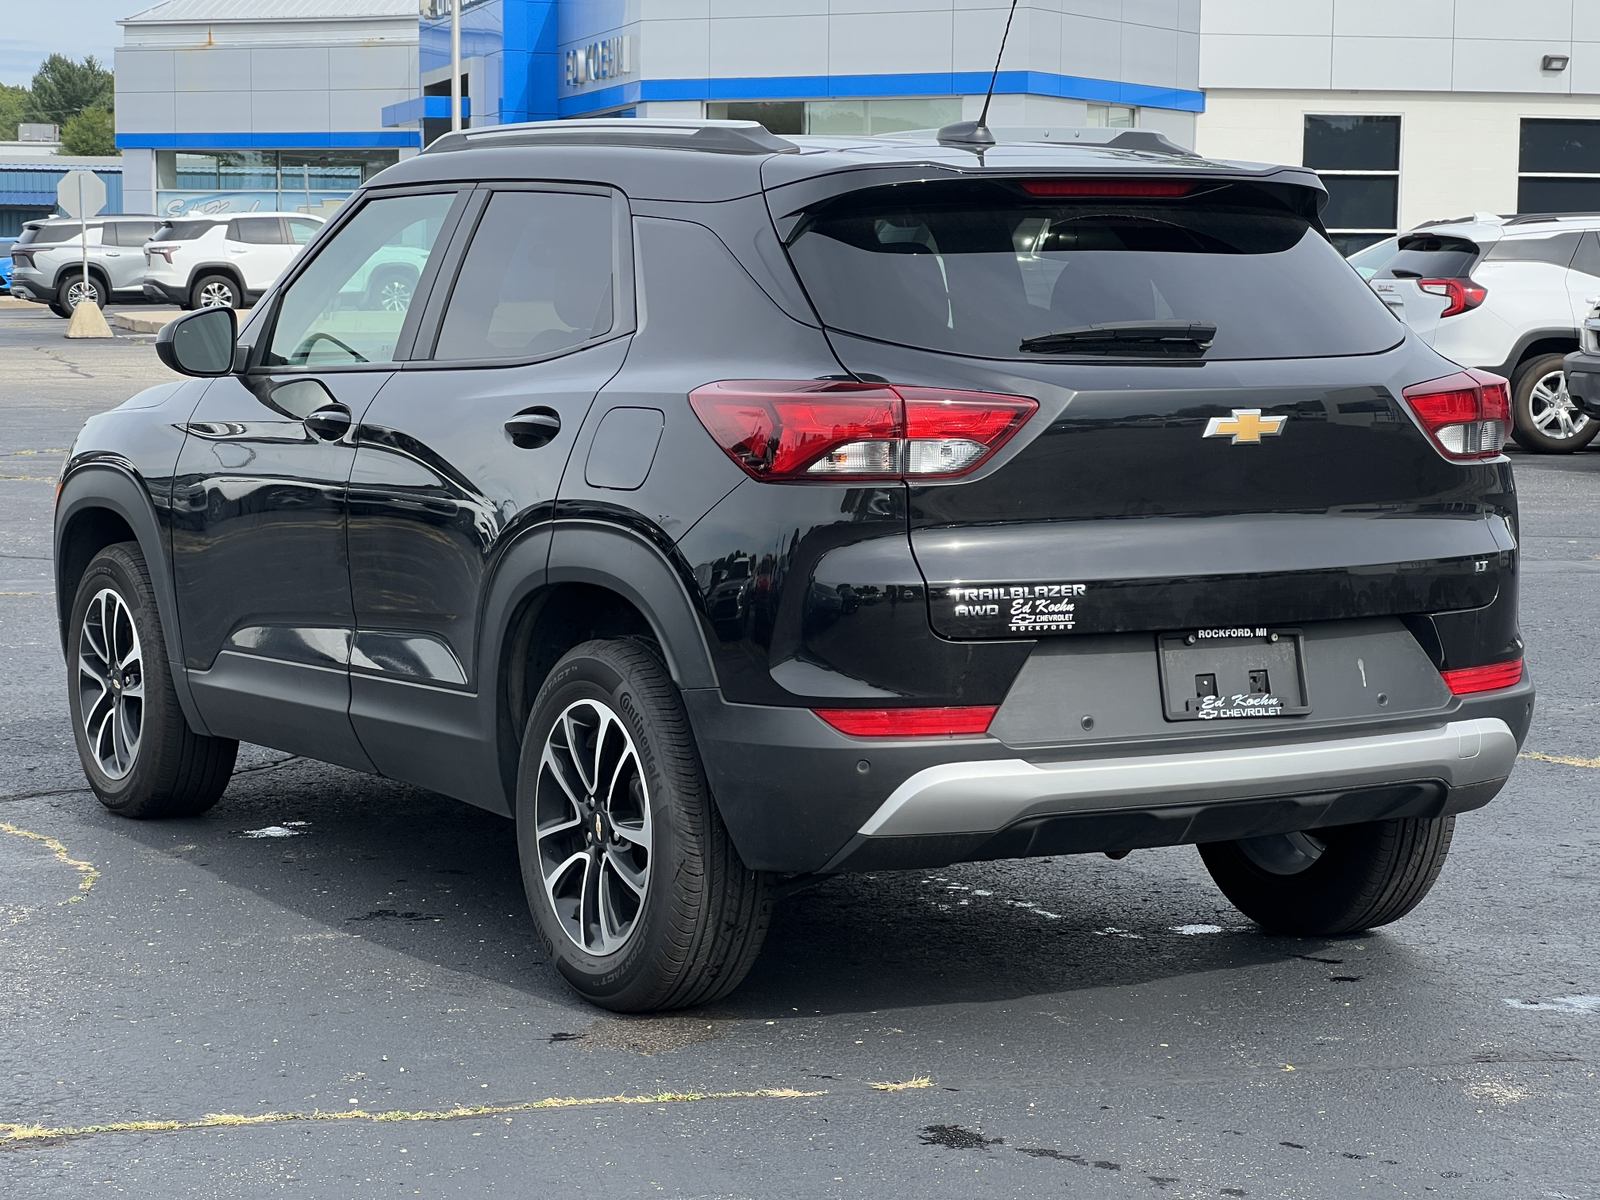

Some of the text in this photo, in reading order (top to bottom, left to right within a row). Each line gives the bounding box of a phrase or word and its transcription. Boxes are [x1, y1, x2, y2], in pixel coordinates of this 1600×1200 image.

[1475, 560, 1489, 572] LT
[949, 584, 1086, 602] TRAILBLAZER
[954, 604, 999, 617] AWD
[1010, 598, 1075, 614] Ed Koehn
[1036, 614, 1073, 622] CHEVROLET
[1011, 624, 1073, 632] ROCKFORD
[1198, 628, 1267, 638] ROCKFORD, MI
[1201, 694, 1279, 709] Ed Koehn
[1220, 706, 1283, 718] CHEVROLET
[620, 692, 660, 781] Continental
